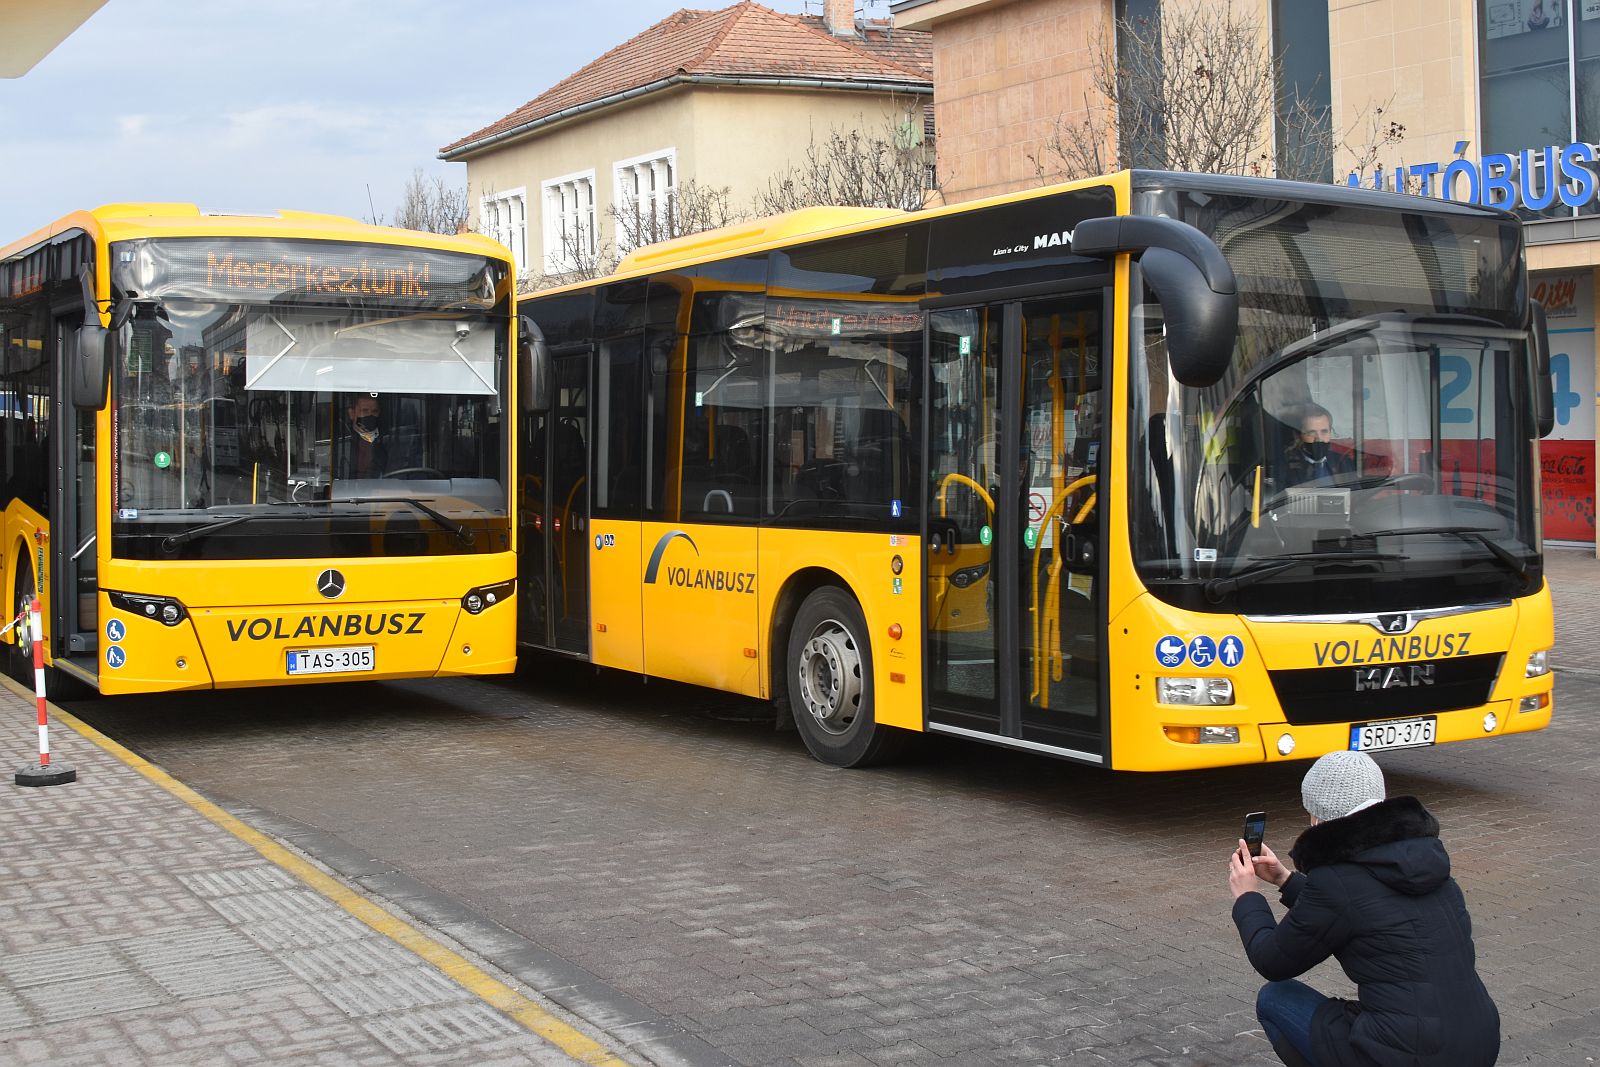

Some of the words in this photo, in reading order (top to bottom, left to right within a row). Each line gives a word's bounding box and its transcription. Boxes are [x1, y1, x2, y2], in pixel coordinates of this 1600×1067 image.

[993, 247, 1012, 256] Lion's
[1013, 245, 1029, 253] City
[1033, 230, 1075, 250] MAN
[207, 250, 430, 296] Megérkeztünk!
[667, 566, 756, 594] VOLÁNBUSZ
[226, 612, 426, 642] VOLÁNBUSZ
[300, 651, 370, 669] TAS-305
[1314, 632, 1471, 666] VOLÁNBUSZ
[1354, 664, 1436, 692] MAN
[1363, 722, 1432, 747] SRD-376
